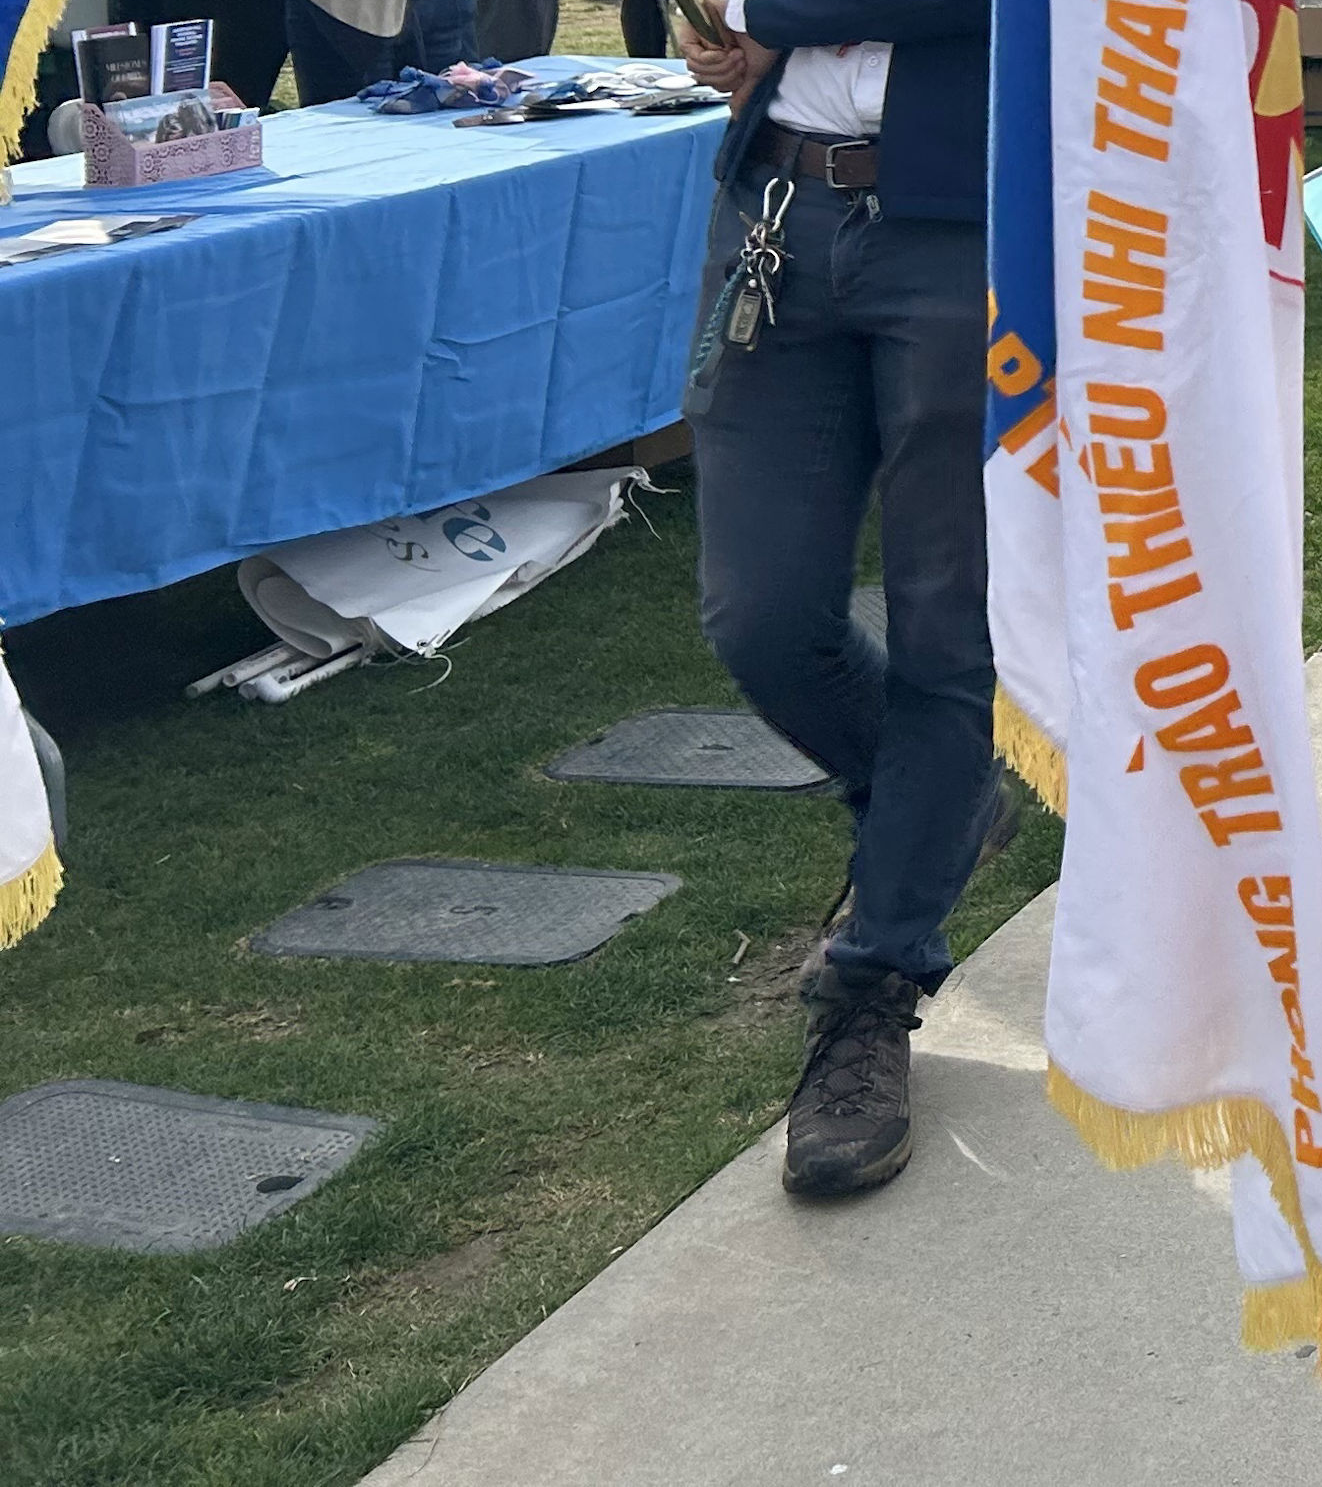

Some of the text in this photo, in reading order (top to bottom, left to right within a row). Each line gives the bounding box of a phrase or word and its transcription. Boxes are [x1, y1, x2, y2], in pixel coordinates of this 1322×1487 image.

[1083, 189, 1169, 352] NHI
[1058, 383, 1203, 631] THIẾU
[1125, 643, 1283, 848] TRÀO
